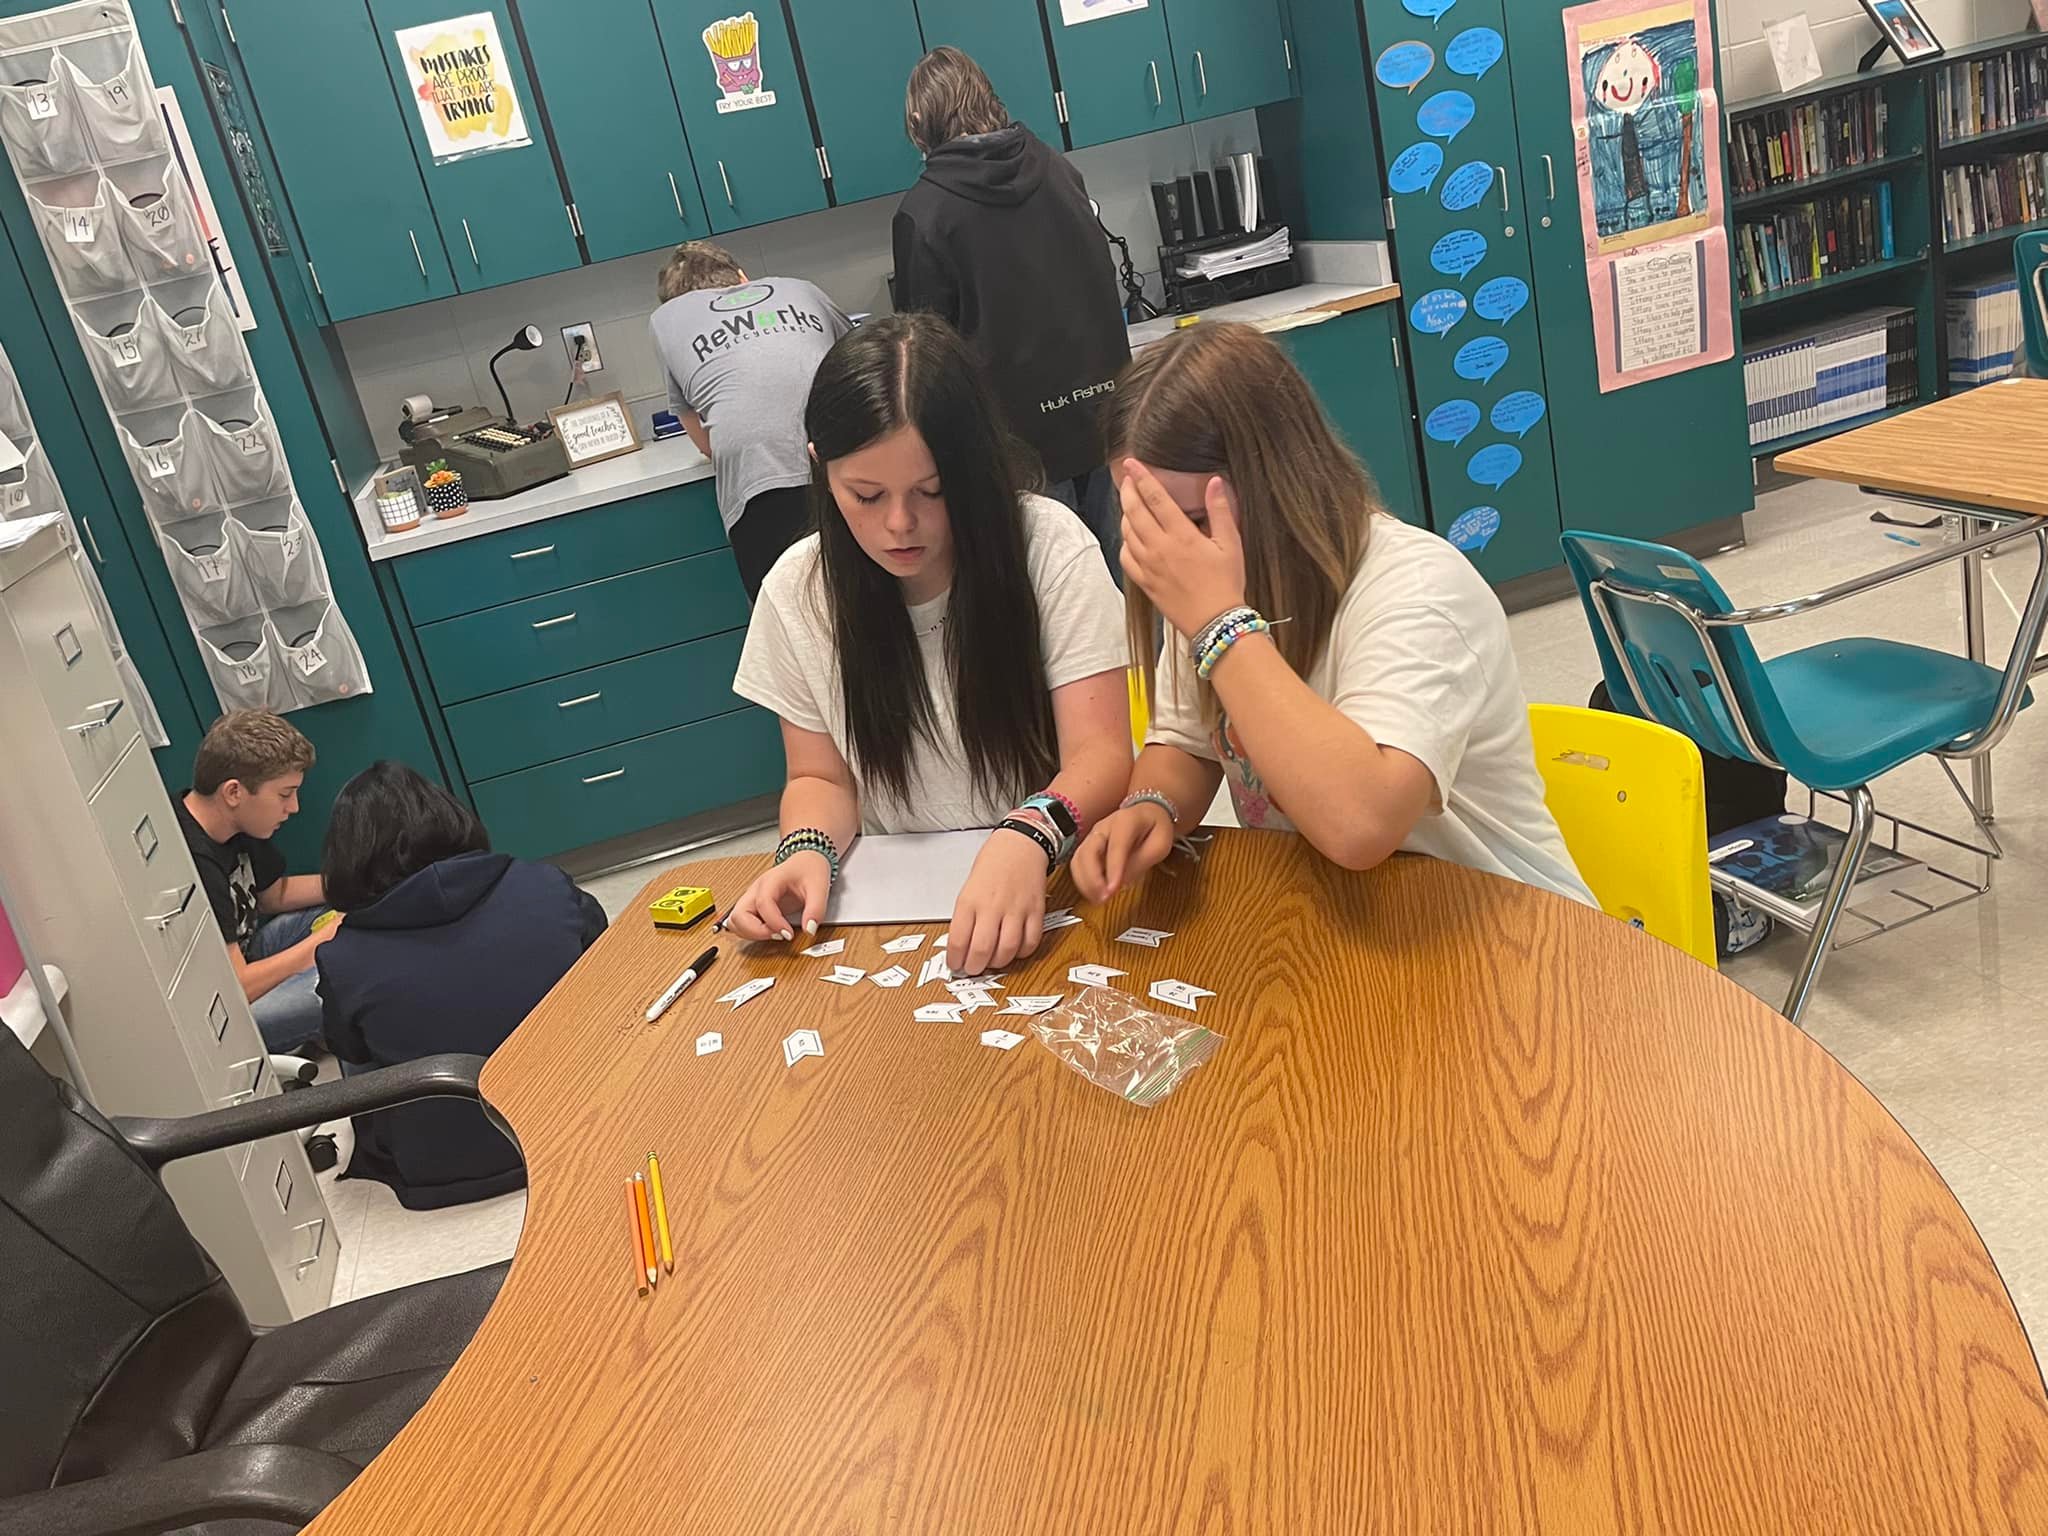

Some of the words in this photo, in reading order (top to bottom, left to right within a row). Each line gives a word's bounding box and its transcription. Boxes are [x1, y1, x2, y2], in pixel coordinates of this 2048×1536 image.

[420, 44, 490, 75] MISTAKES
[433, 71, 455, 91] ARE
[456, 64, 489, 85] PROOF
[108, 85, 128, 104] 19
[432, 87, 457, 104] THAT
[458, 84, 476, 98] YOU
[478, 80, 497, 94] ARE
[719, 102, 731, 111] TRY
[733, 97, 753, 107] YOUR
[755, 94, 772, 104] BEST
[31, 93, 50, 115] 13
[442, 94, 495, 121] TRYING
[72, 215, 90, 236] 14
[149, 206, 169, 227] 20
[692, 304, 823, 362] ReWorks
[116, 339, 137, 361] 15
[1040, 396, 1071, 413] Huk
[1072, 380, 1115, 401] Fishing
[235, 434, 263, 452] 22
[573, 425, 591, 443] good
[148, 452, 169, 472] 16
[200, 556, 220, 579] 17
[299, 648, 323, 670] 24
